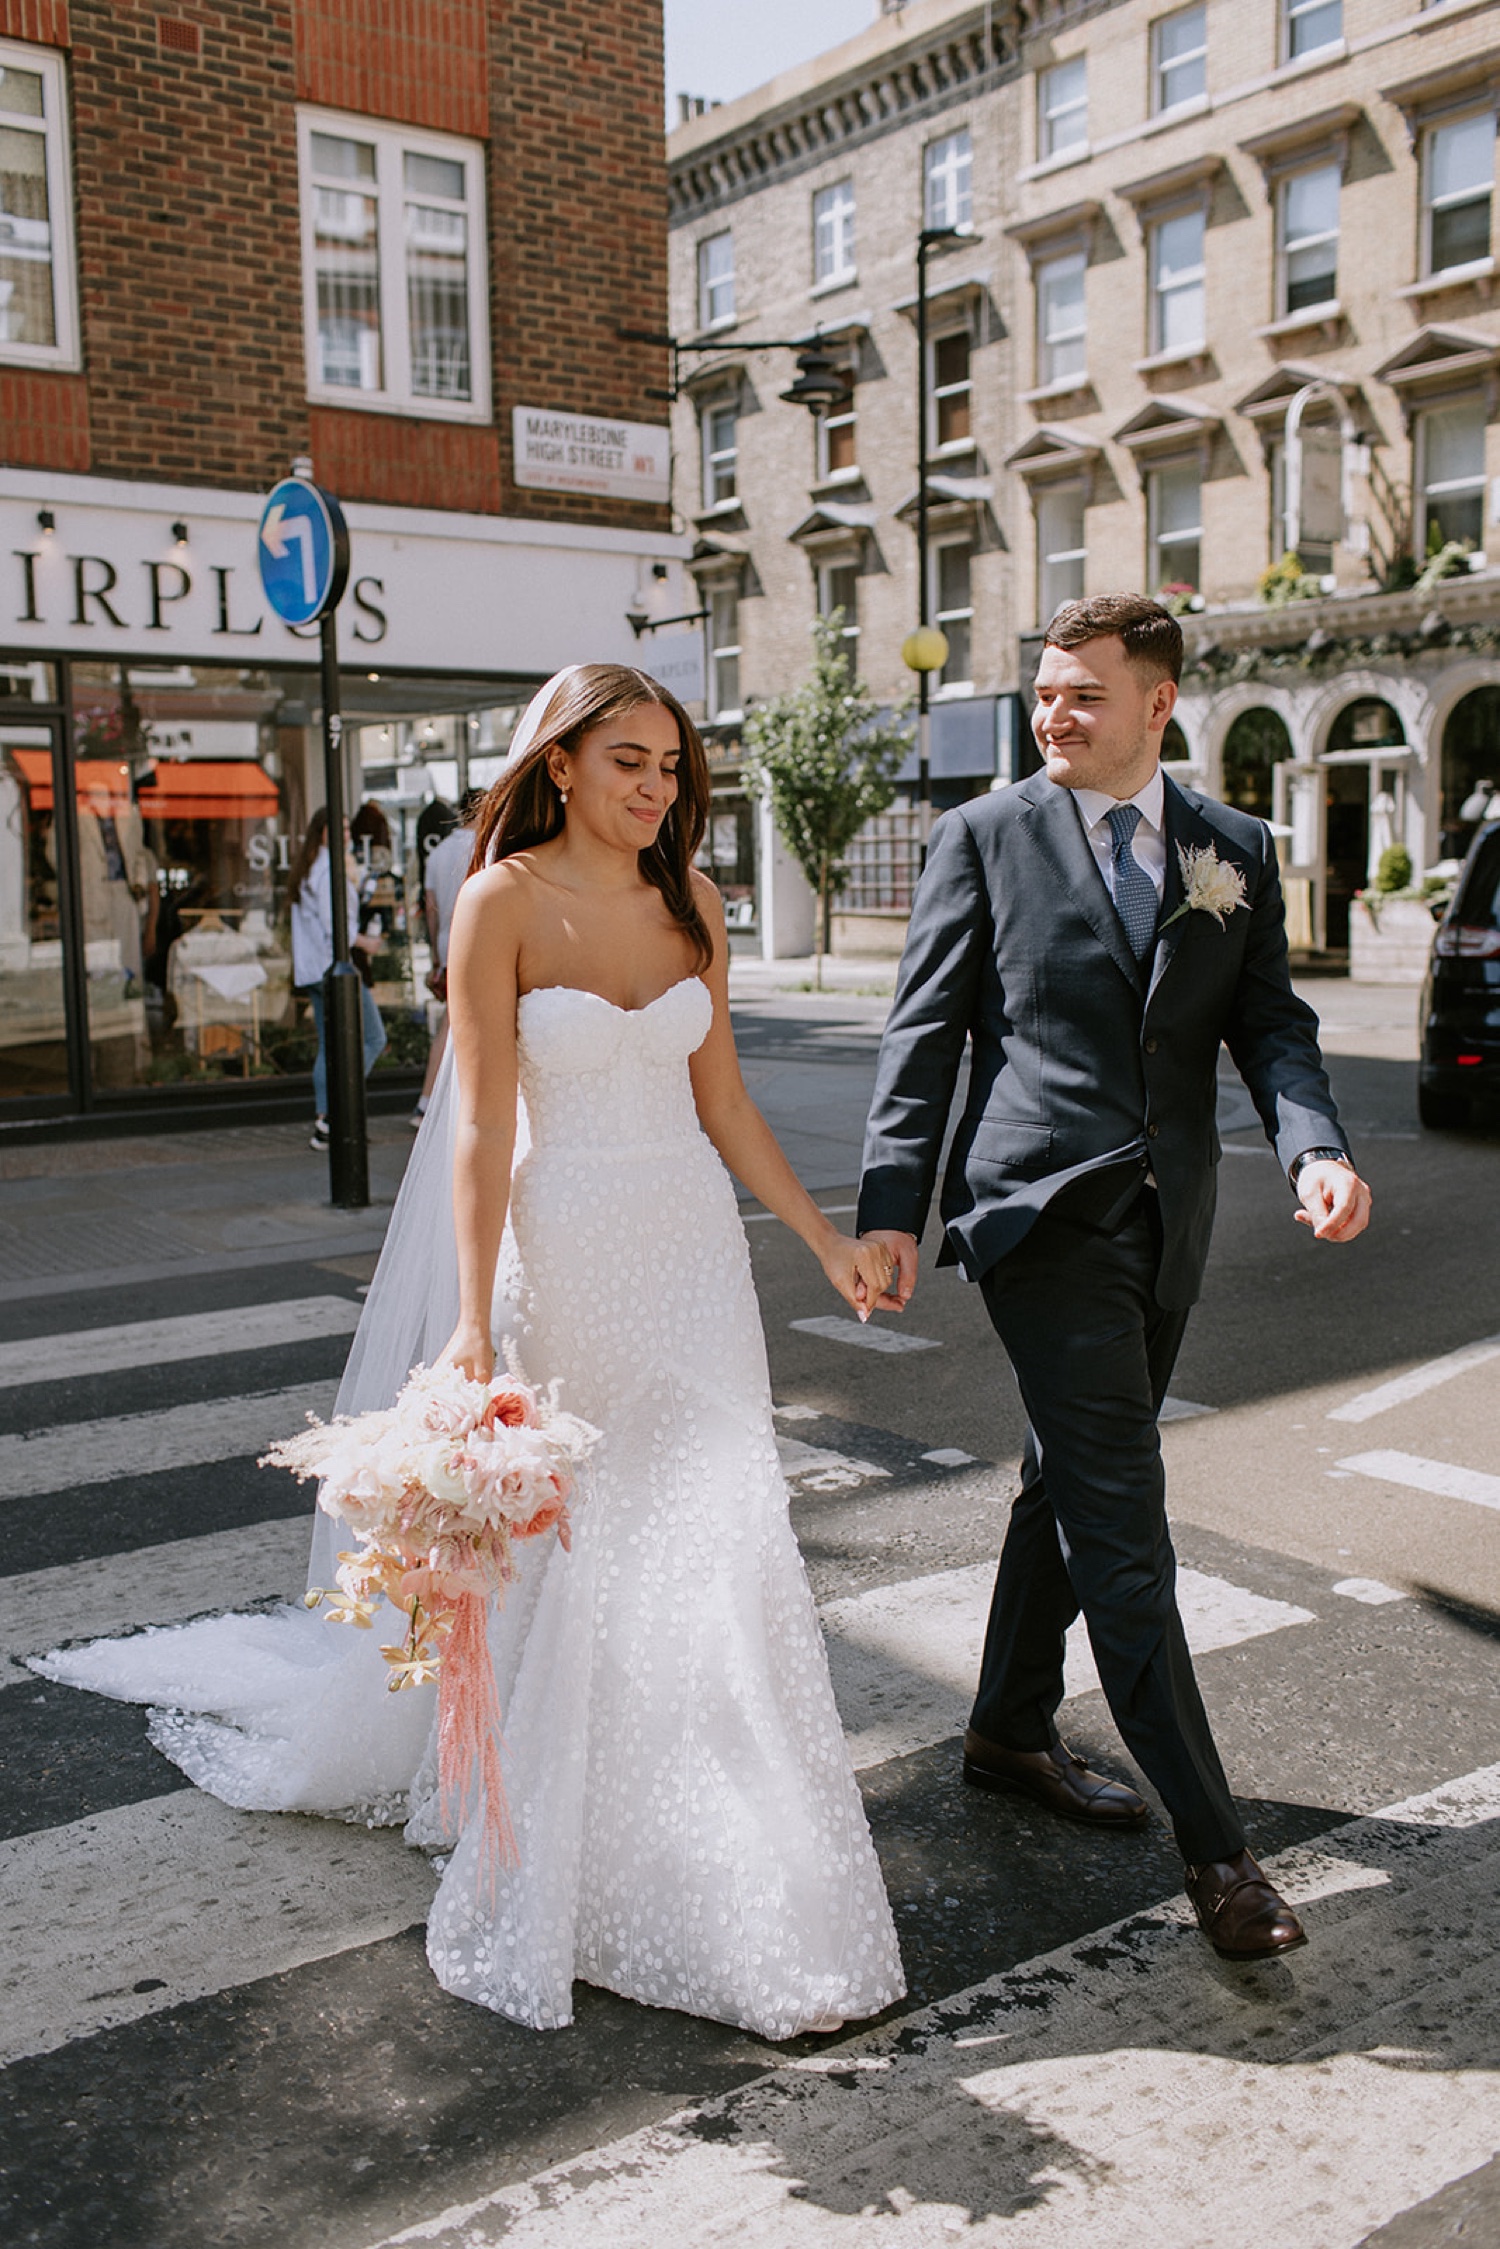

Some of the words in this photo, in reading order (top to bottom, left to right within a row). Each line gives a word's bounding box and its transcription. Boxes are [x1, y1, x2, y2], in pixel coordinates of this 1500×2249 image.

[526, 416, 628, 449] MARYLEBONE
[526, 440, 564, 463] HIGH
[567, 444, 624, 470] STREET
[12, 550, 388, 643] IRPLS
